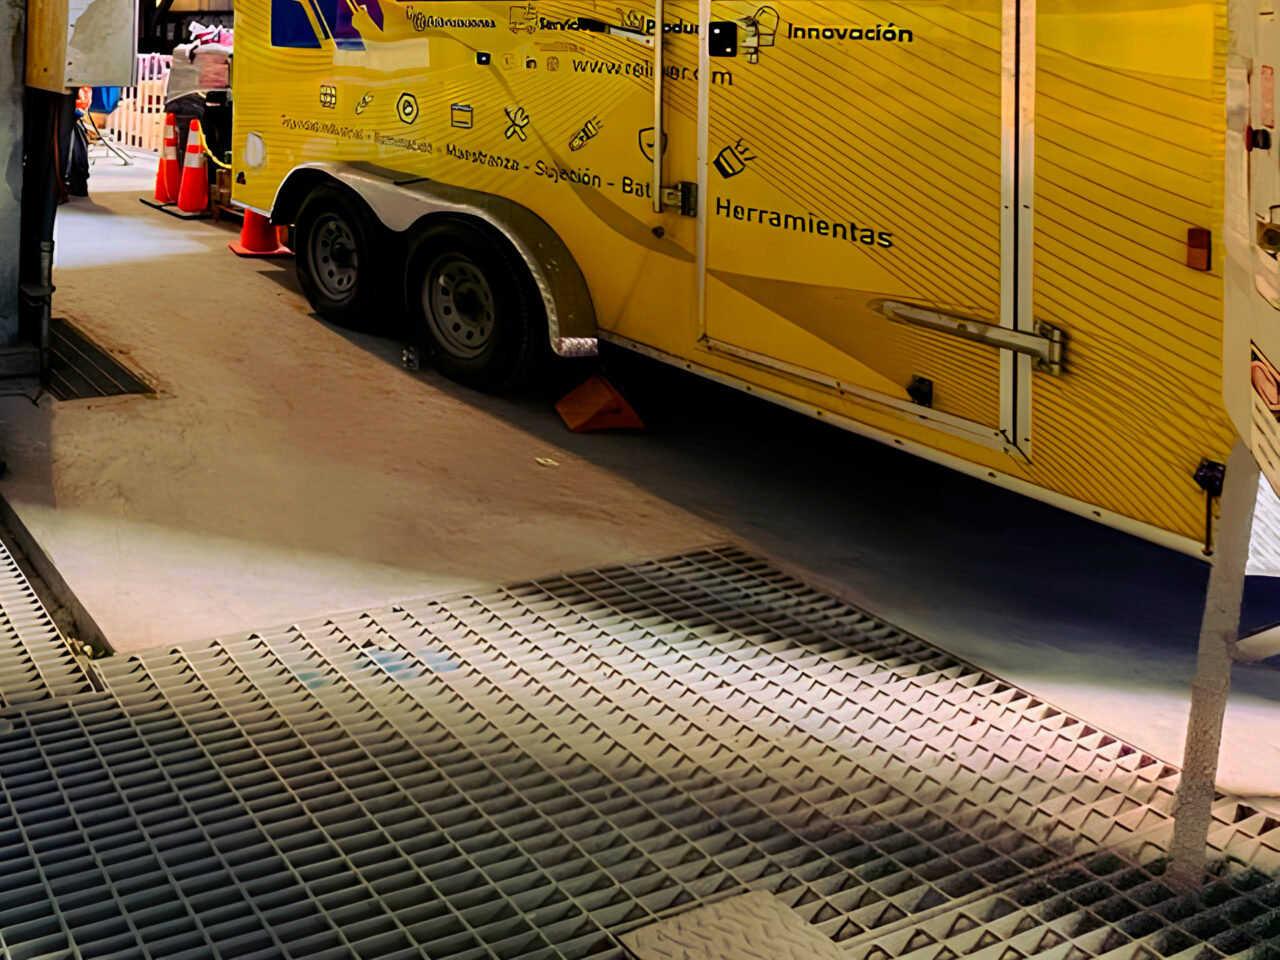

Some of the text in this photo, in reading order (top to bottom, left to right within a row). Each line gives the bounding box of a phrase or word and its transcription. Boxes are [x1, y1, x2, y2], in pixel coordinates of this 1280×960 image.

[788, 22, 913, 43] Innovación
[622, 176, 653, 198] Bat
[716, 196, 894, 249] Herramientas
